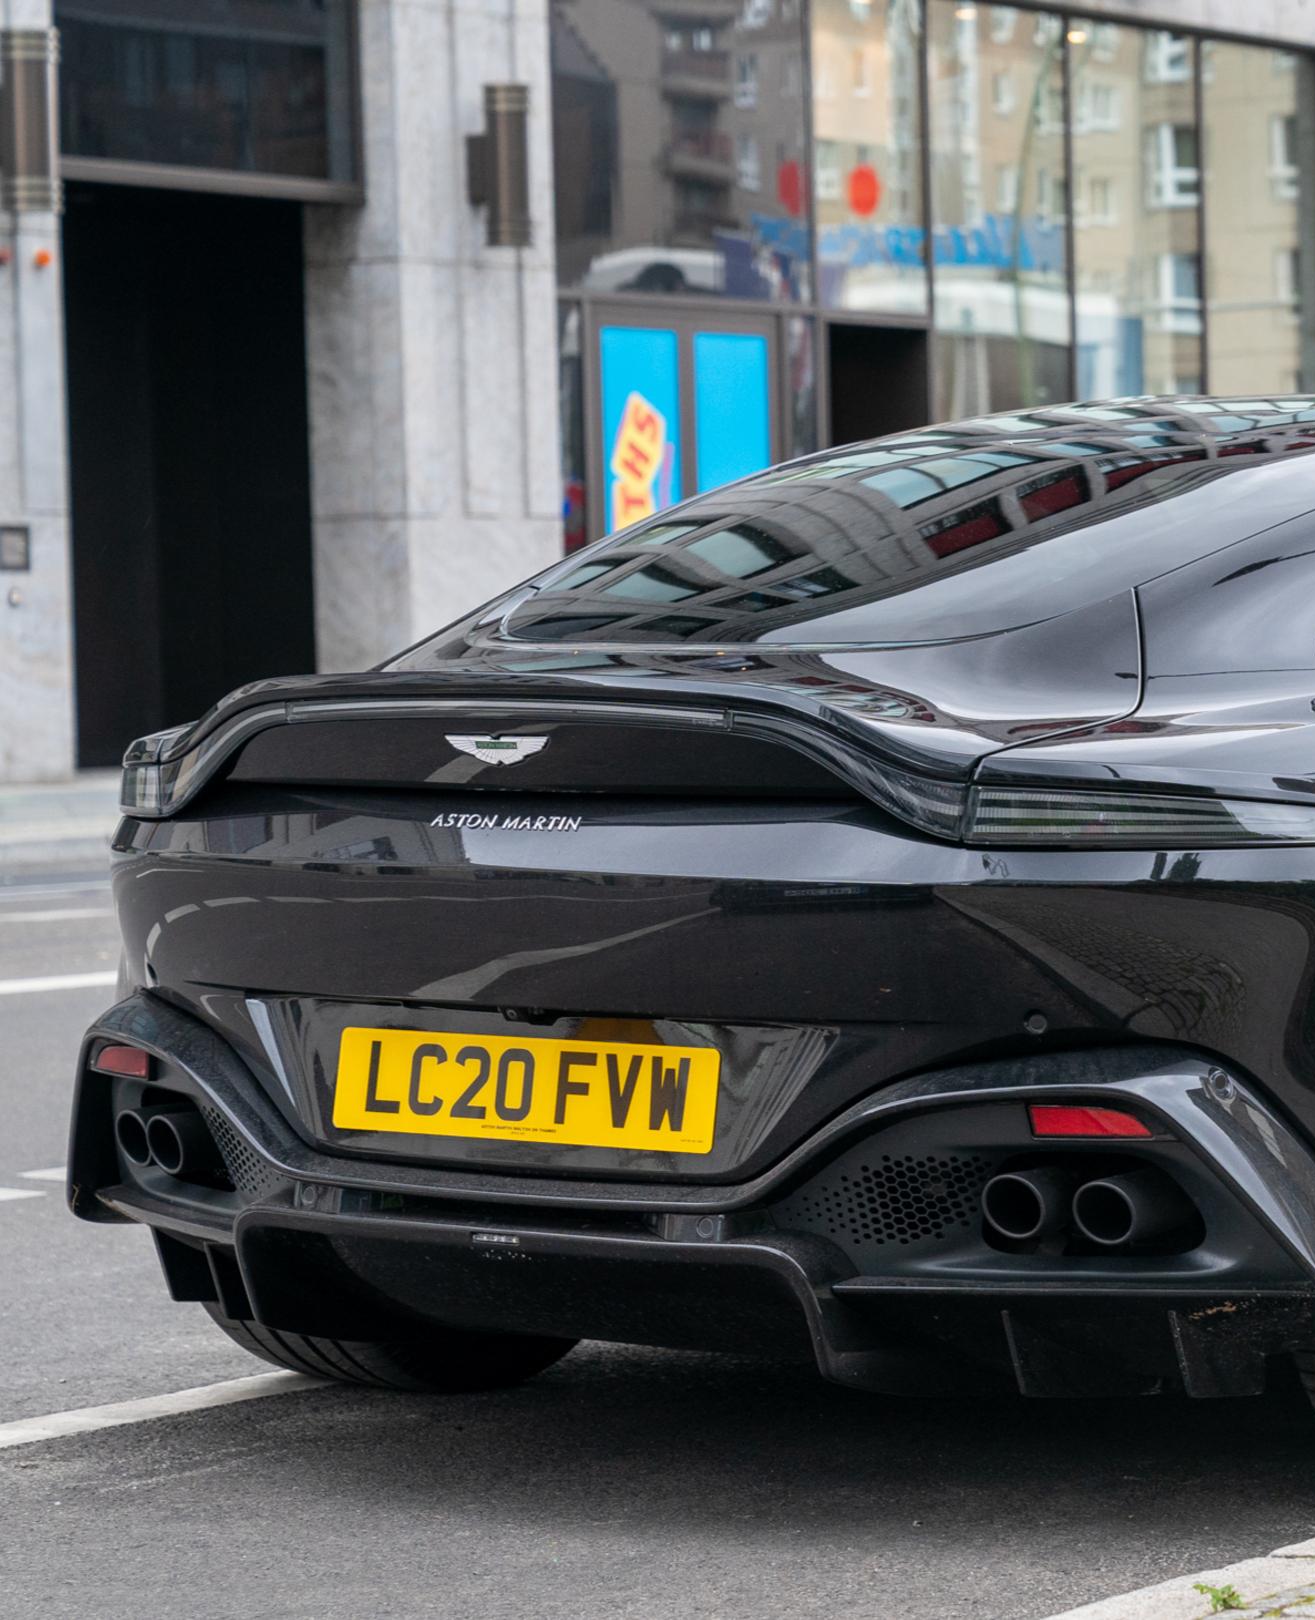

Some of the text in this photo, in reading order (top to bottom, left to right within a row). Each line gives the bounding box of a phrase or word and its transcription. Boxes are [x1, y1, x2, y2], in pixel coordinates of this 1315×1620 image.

[430, 813, 582, 832] ASTON MARTIN
[365, 1040, 691, 1132] LC20 FVW
